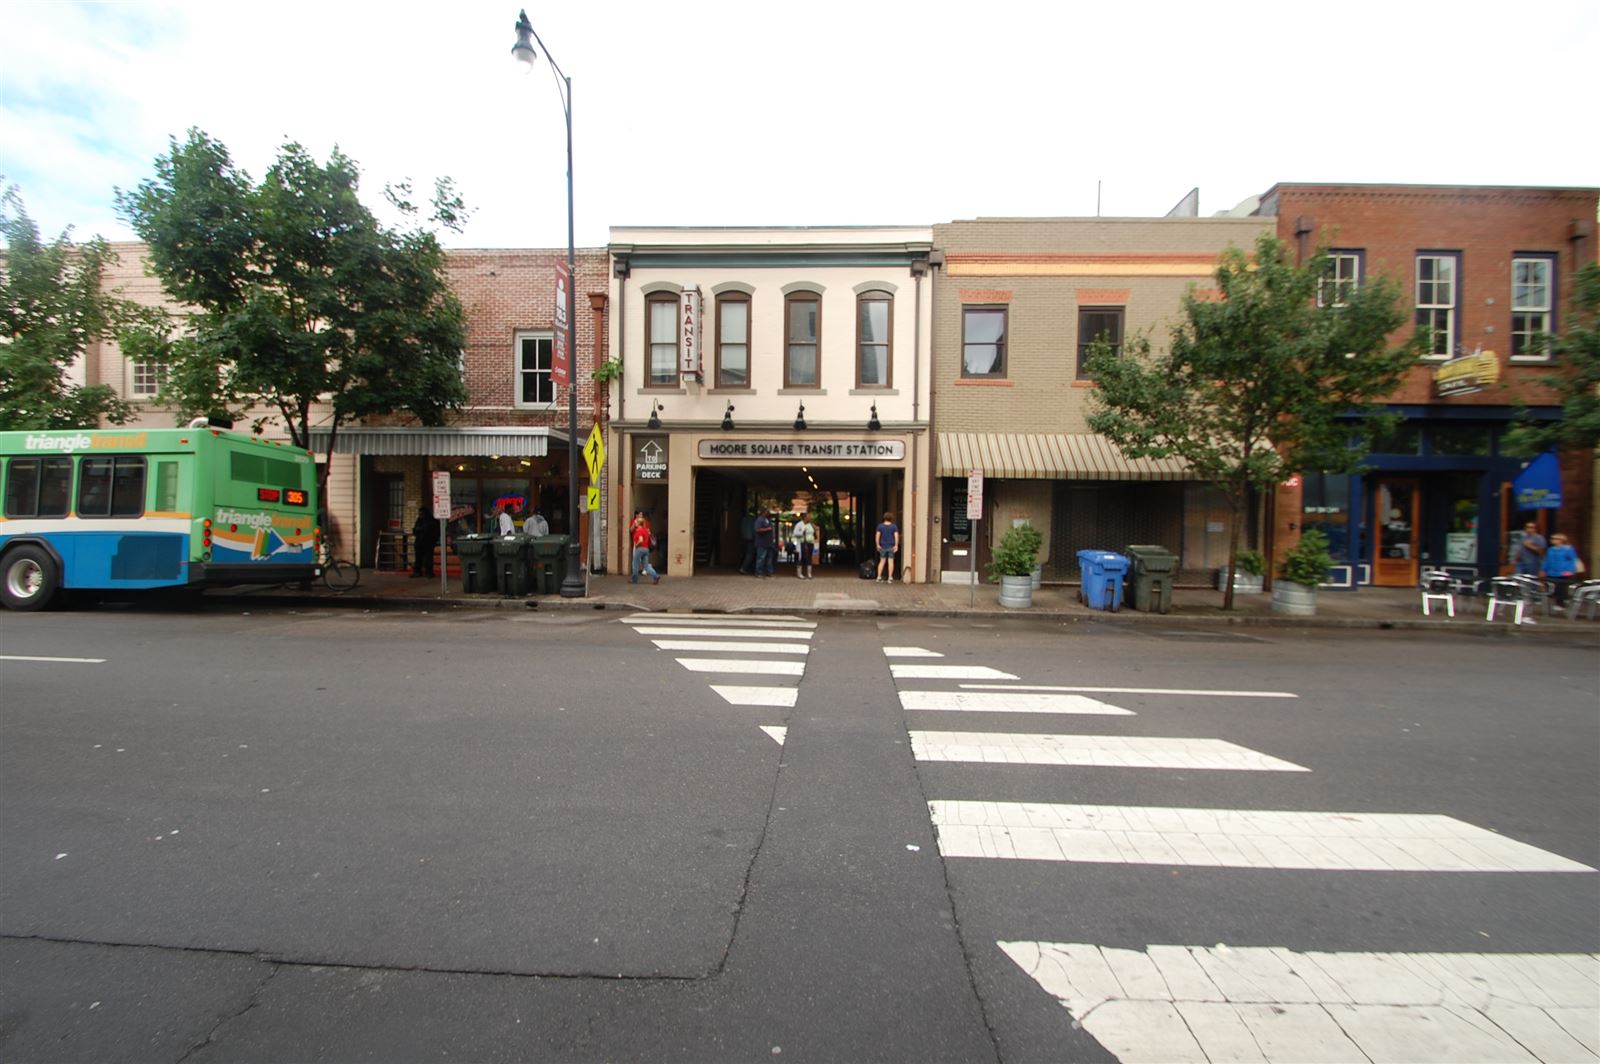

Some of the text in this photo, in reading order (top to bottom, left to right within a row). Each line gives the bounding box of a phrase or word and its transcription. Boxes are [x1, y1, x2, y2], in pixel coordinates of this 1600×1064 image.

[684, 293, 694, 369] TRANSIT
[25, 433, 91, 453] triangle
[710, 444, 893, 455] MOORE SQUARE TRANSIT STATION
[636, 463, 667, 471] PARKING
[216, 509, 272, 529] triangle
